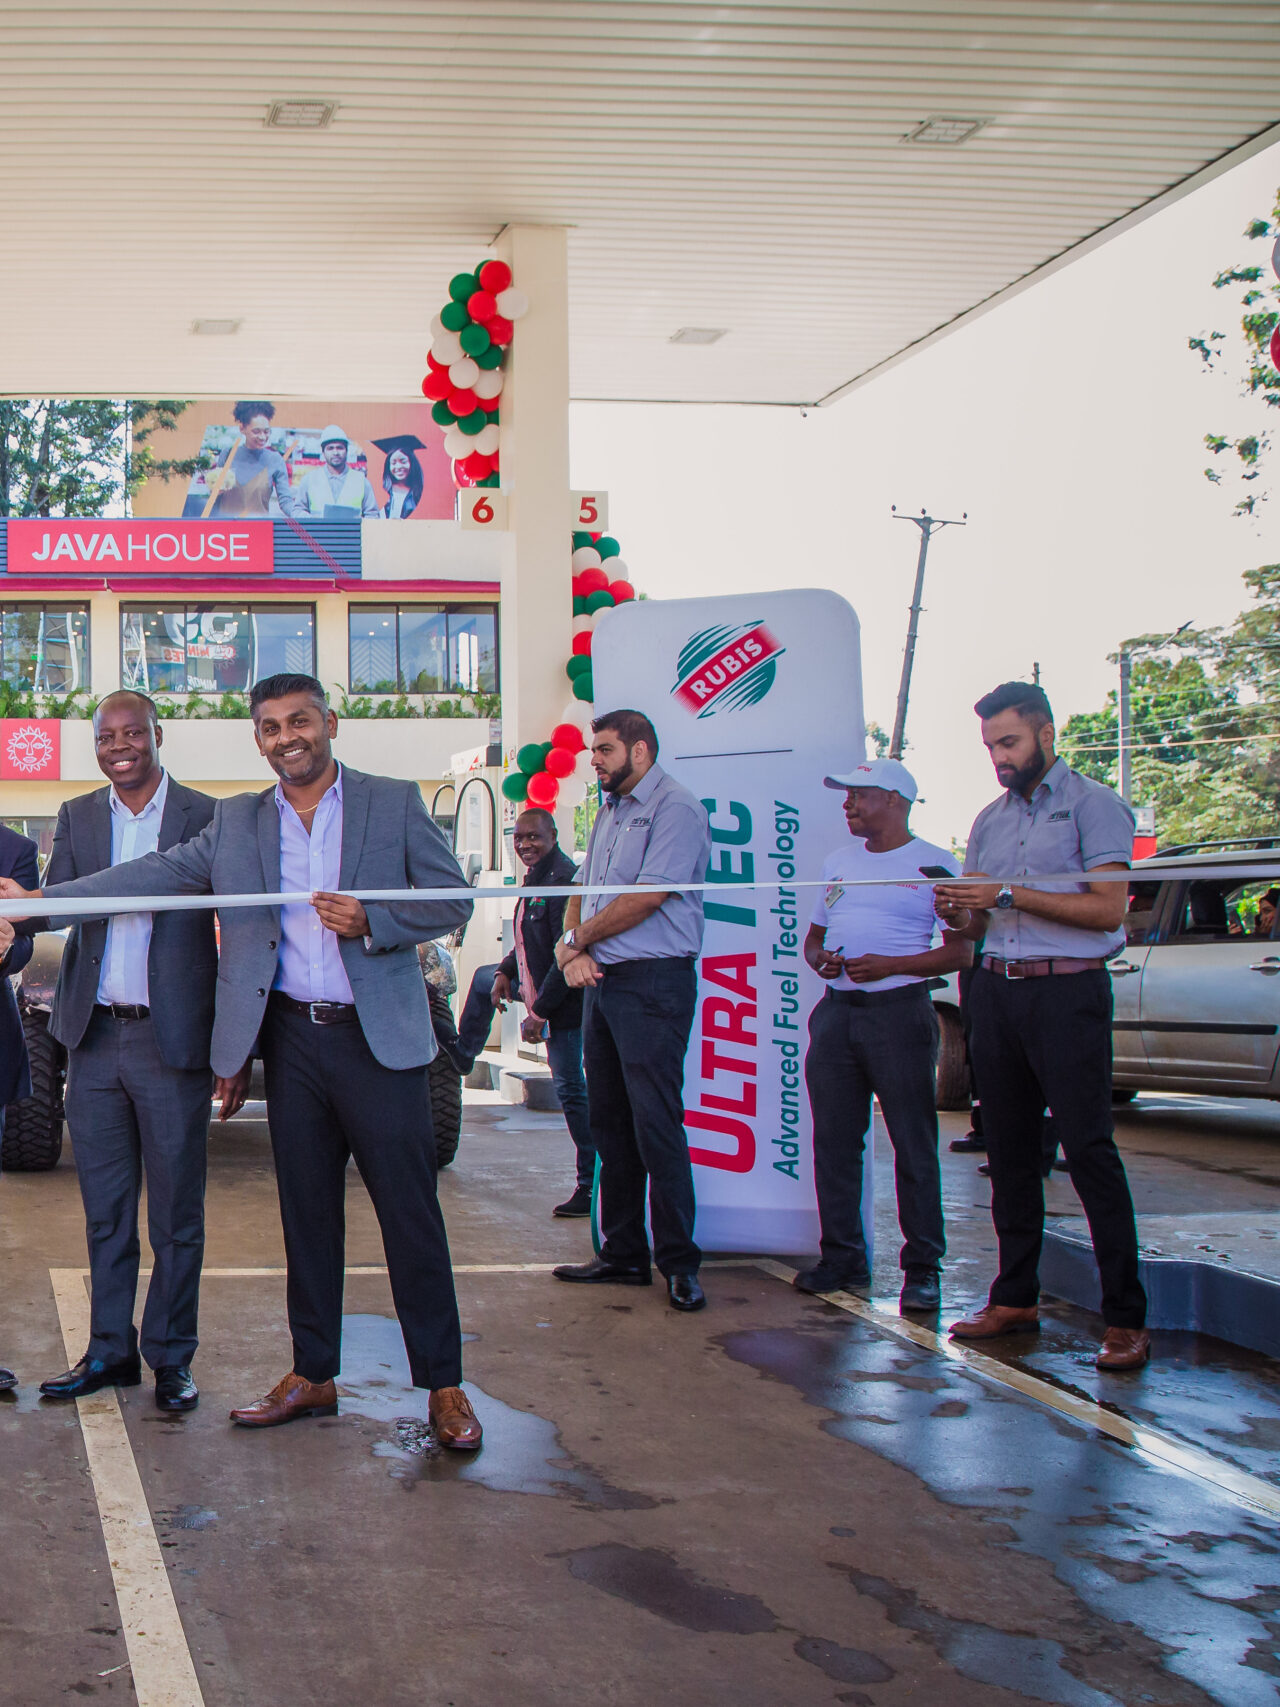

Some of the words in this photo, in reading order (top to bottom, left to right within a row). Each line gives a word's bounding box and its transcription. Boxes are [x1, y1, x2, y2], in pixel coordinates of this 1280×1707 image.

[472, 496, 494, 524] 6
[578, 497, 598, 524] 5
[31, 533, 123, 561] JAVA
[127, 533, 250, 561] HOUSE
[768, 800, 800, 960] Technology
[771, 970, 800, 1030] Fuel
[682, 952, 757, 1173] ULTRA
[771, 1039, 800, 1180] Advanced
